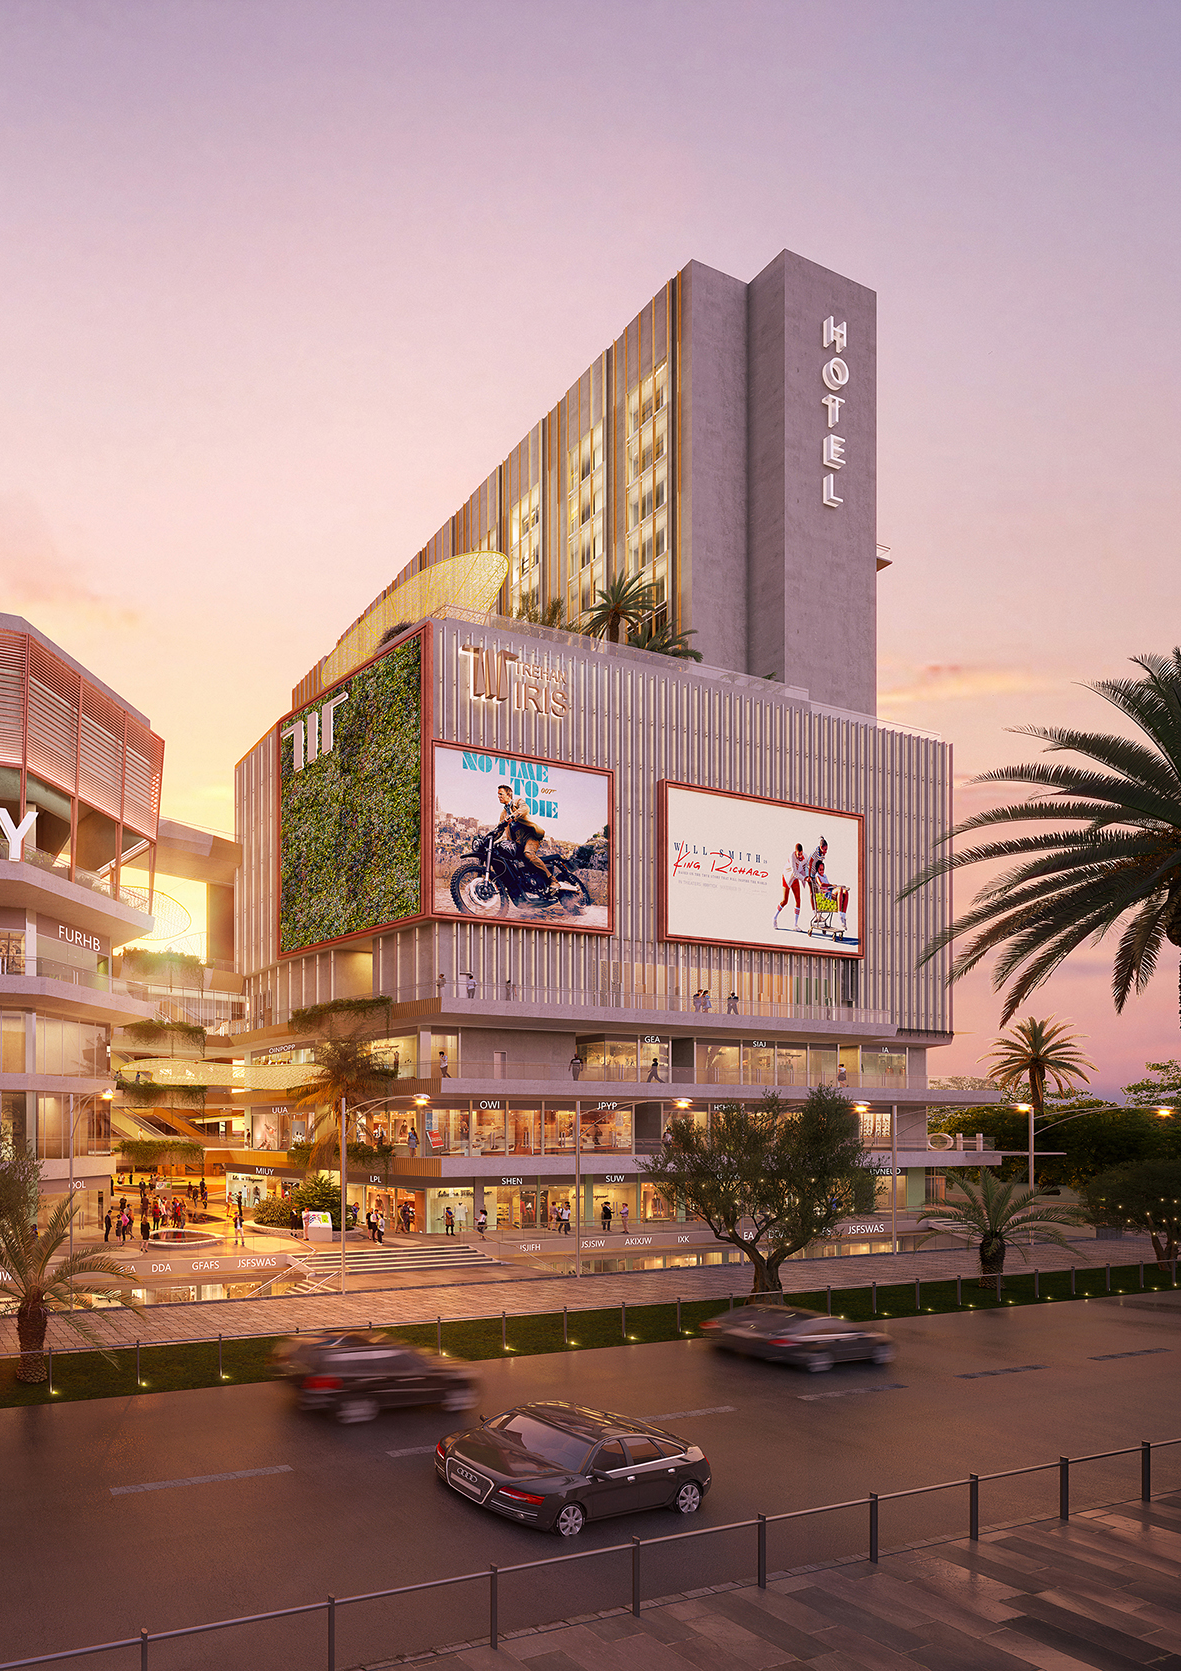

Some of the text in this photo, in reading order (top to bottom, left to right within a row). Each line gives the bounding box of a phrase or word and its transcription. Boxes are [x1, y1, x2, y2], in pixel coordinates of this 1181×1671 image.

[821, 315, 850, 508] HOTEL
[514, 660, 567, 685] TREHAN
[515, 681, 569, 719] IRIS
[462, 751, 549, 783] NO TIME
[510, 777, 557, 798] TO 007
[525, 797, 559, 819] DIE
[673, 842, 708, 856] WILL
[719, 848, 761, 863] SMITH
[58, 924, 101, 952] FURHB
[644, 1035, 660, 1043] GEA
[752, 1040, 767, 1048] SIAJ
[271, 1106, 289, 1114] UUA
[479, 1100, 500, 1110] OWI
[596, 1101, 618, 1111] JPYP
[255, 1167, 275, 1176] MIUY
[369, 1175, 382, 1184] LPL
[501, 1177, 523, 1185] SHEN
[605, 1175, 625, 1183] SUW
[581, 1240, 606, 1249] JSJSIW
[624, 1237, 653, 1246] AKIXJW
[677, 1235, 690, 1243] IXK
[847, 1224, 885, 1235] JSFSWAS
[151, 1263, 172, 1273] DDA
[191, 1260, 220, 1271] GFAFS
[237, 1257, 277, 1268] JSFSWAS
